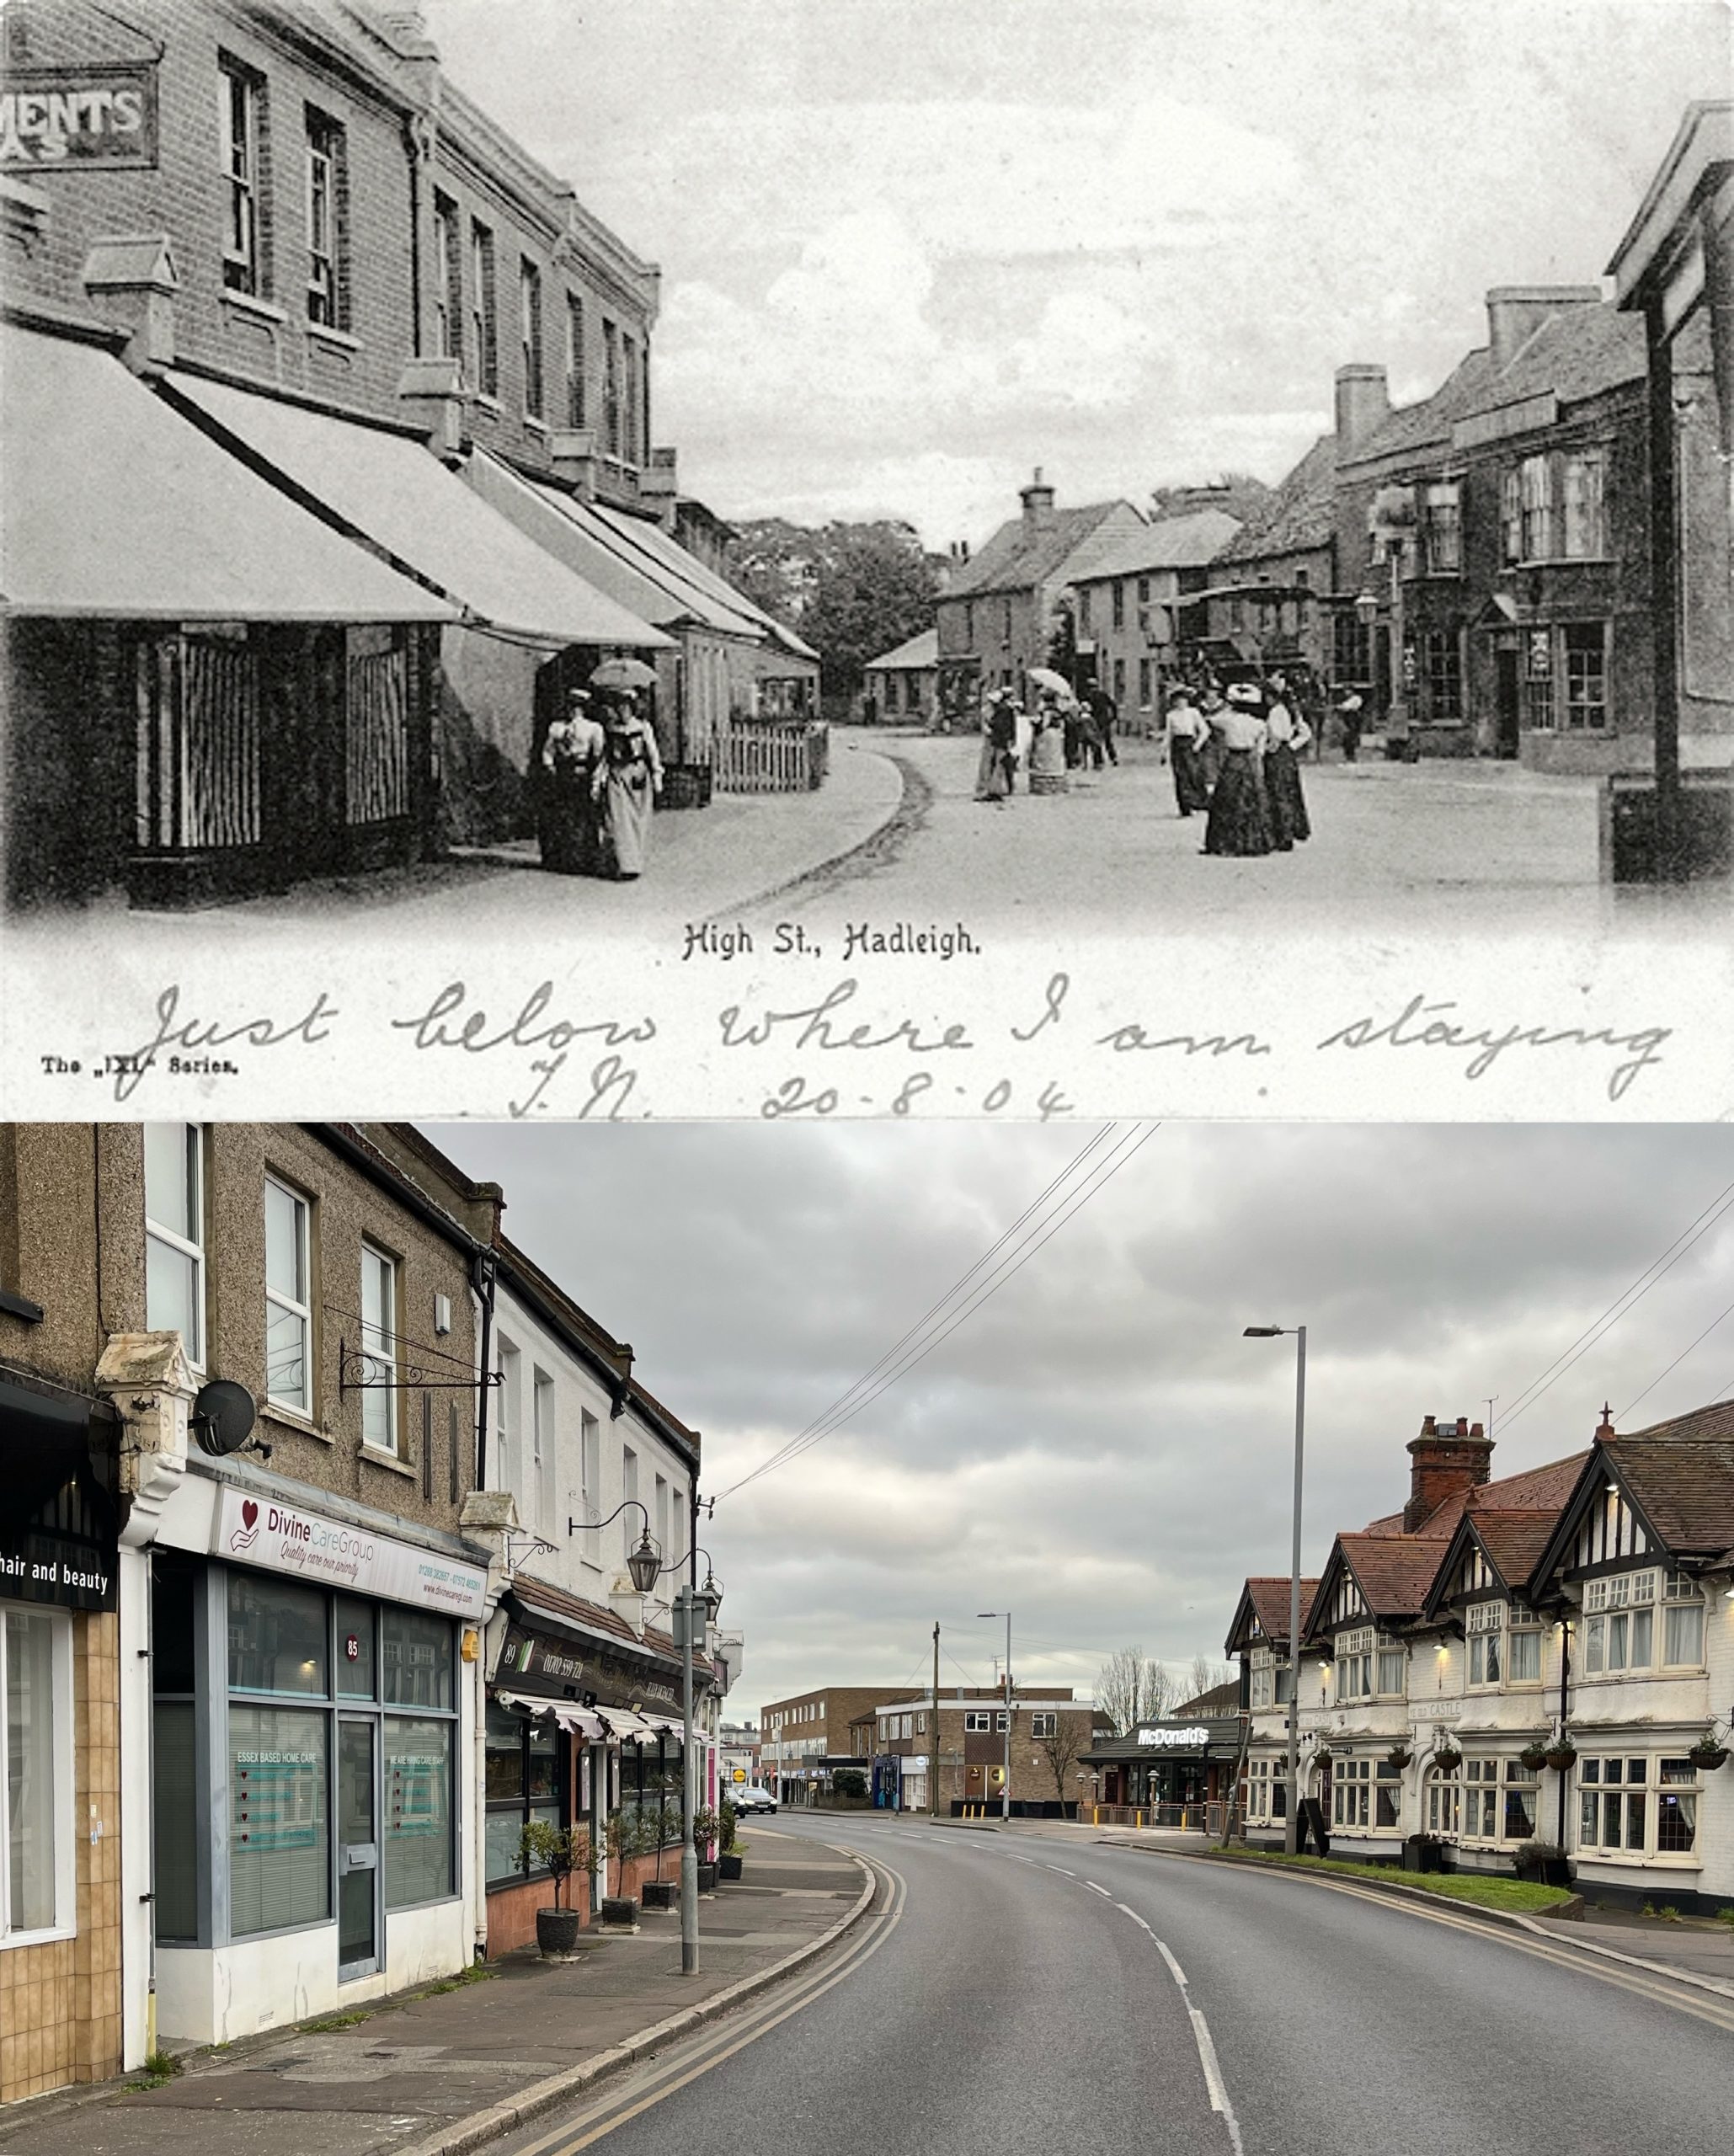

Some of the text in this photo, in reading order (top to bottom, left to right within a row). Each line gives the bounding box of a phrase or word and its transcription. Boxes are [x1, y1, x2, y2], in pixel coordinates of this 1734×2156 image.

[115, 972, 1673, 1102] Just below where I am staying
[280, 1541, 359, 1583] Quality care our priority
[0, 1551, 108, 1595] hair and beauty
[348, 1641, 358, 1657] 85
[504, 1644, 516, 1664] 89
[1138, 1727, 1209, 1745] McDonald's
[237, 1752, 317, 1763] ESSEX BASED HOME CARE
